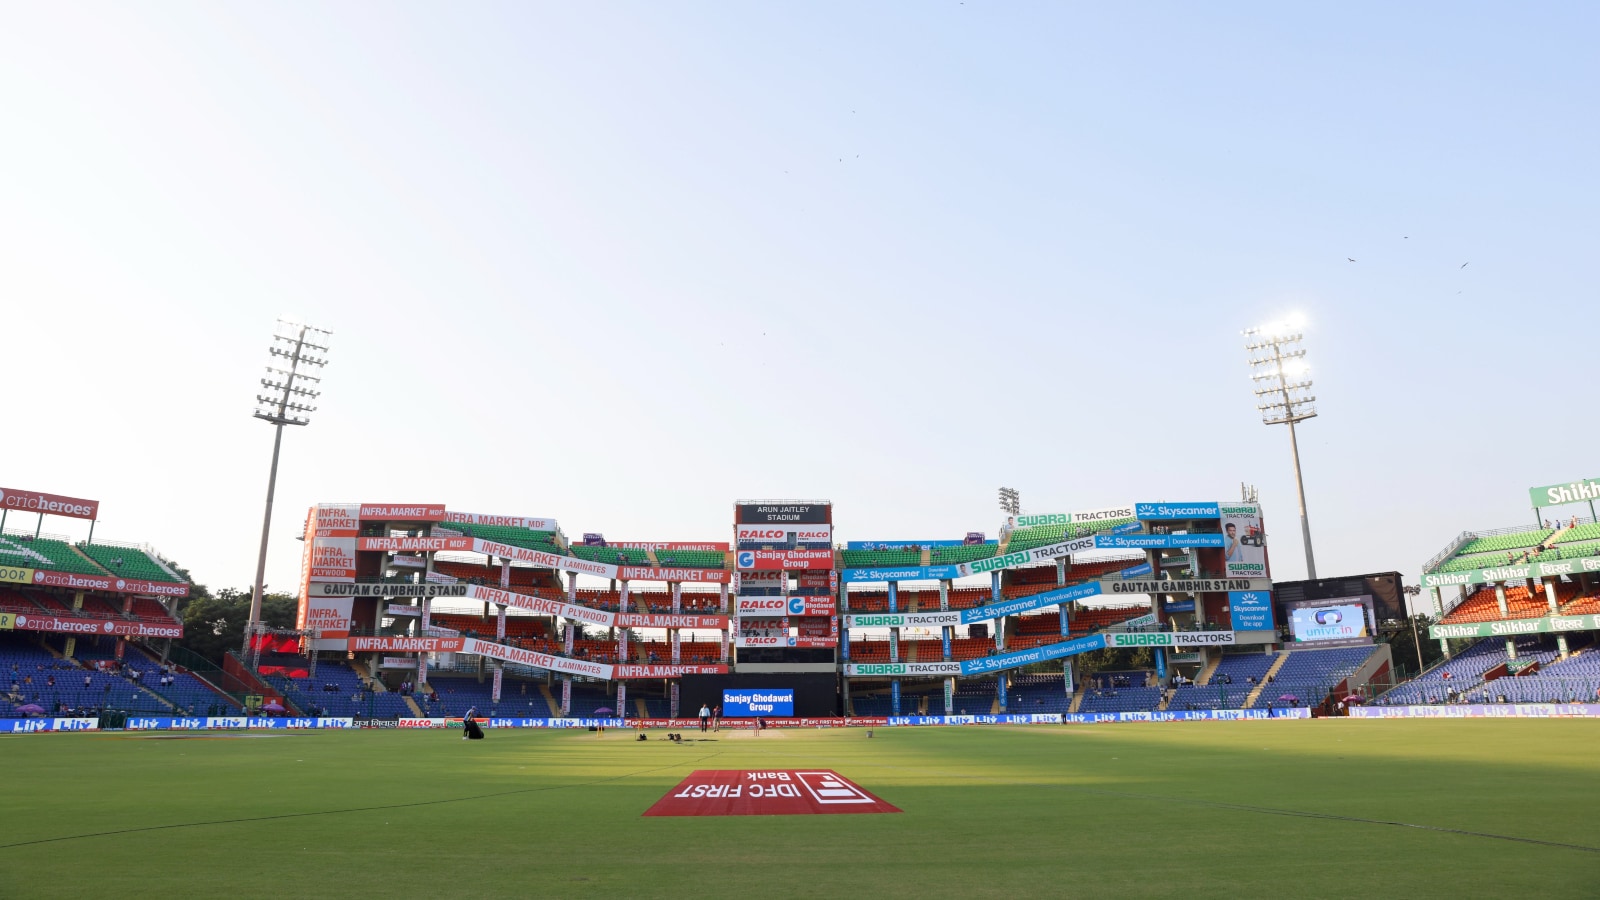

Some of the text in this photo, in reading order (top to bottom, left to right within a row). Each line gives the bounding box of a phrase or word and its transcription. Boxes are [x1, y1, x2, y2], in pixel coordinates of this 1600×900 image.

[6, 494, 92, 516] cricheroes
[318, 508, 350, 518] INFRA.
[361, 507, 428, 517] INFRA.MARKET
[1075, 508, 1132, 521] TRACTORS
[1158, 506, 1217, 517] Skyscanner
[317, 518, 357, 528] MARKET
[528, 520, 546, 528] MDF
[739, 530, 784, 538] RALCO
[366, 538, 467, 550] INFRA.MARKET MDF
[1115, 538, 1166, 547] Skyscanner
[314, 547, 346, 557] INFRA.
[1033, 539, 1094, 559] TRACTORS
[482, 541, 607, 574] INFRA.MARKET LAMINATES
[756, 551, 786, 560] Sanjay
[313, 558, 354, 568] MARKET
[783, 560, 809, 568] Group
[312, 569, 346, 577] PLYWOOD
[623, 568, 704, 580] INFRA.MARKET
[869, 570, 920, 579] Skyscanner
[1482, 567, 1530, 581] Shikhar
[45, 574, 109, 588] cricheroes
[1113, 580, 1250, 592] GAUTAM GAMBHIR STAND
[1426, 574, 1471, 587] Shikhar
[126, 581, 186, 596] cricheroes
[324, 584, 467, 596] GAUTAM GAMBHIR STAND
[474, 586, 608, 622] INFRA.MARKET PLYWOOD
[740, 600, 784, 608] RALCO
[984, 588, 1095, 618] Skyscanner Download the app
[309, 608, 342, 618] INFRA.
[28, 618, 98, 632] cricheroes
[618, 614, 720, 627] INFRA.MARKET MDF
[907, 615, 958, 624] TRACTORS
[114, 622, 180, 636] cricheroes
[1434, 625, 1480, 638] Shikhar
[1491, 620, 1540, 635] Shikhar
[355, 638, 460, 650] INFRA.MARKET MDF
[1175, 633, 1233, 643] TRACTORS
[474, 640, 602, 674] INFRA.MARKET LAMINATES
[985, 641, 1098, 669] Skyscanner Download the app
[618, 666, 698, 677] INFRA.MARKET
[909, 663, 960, 672] TRACTORS
[724, 694, 792, 704] Sanjay Ghodawat
[749, 703, 774, 712] Group
[747, 772, 792, 781] Bank
[674, 784, 802, 798] IDFC FIRST
